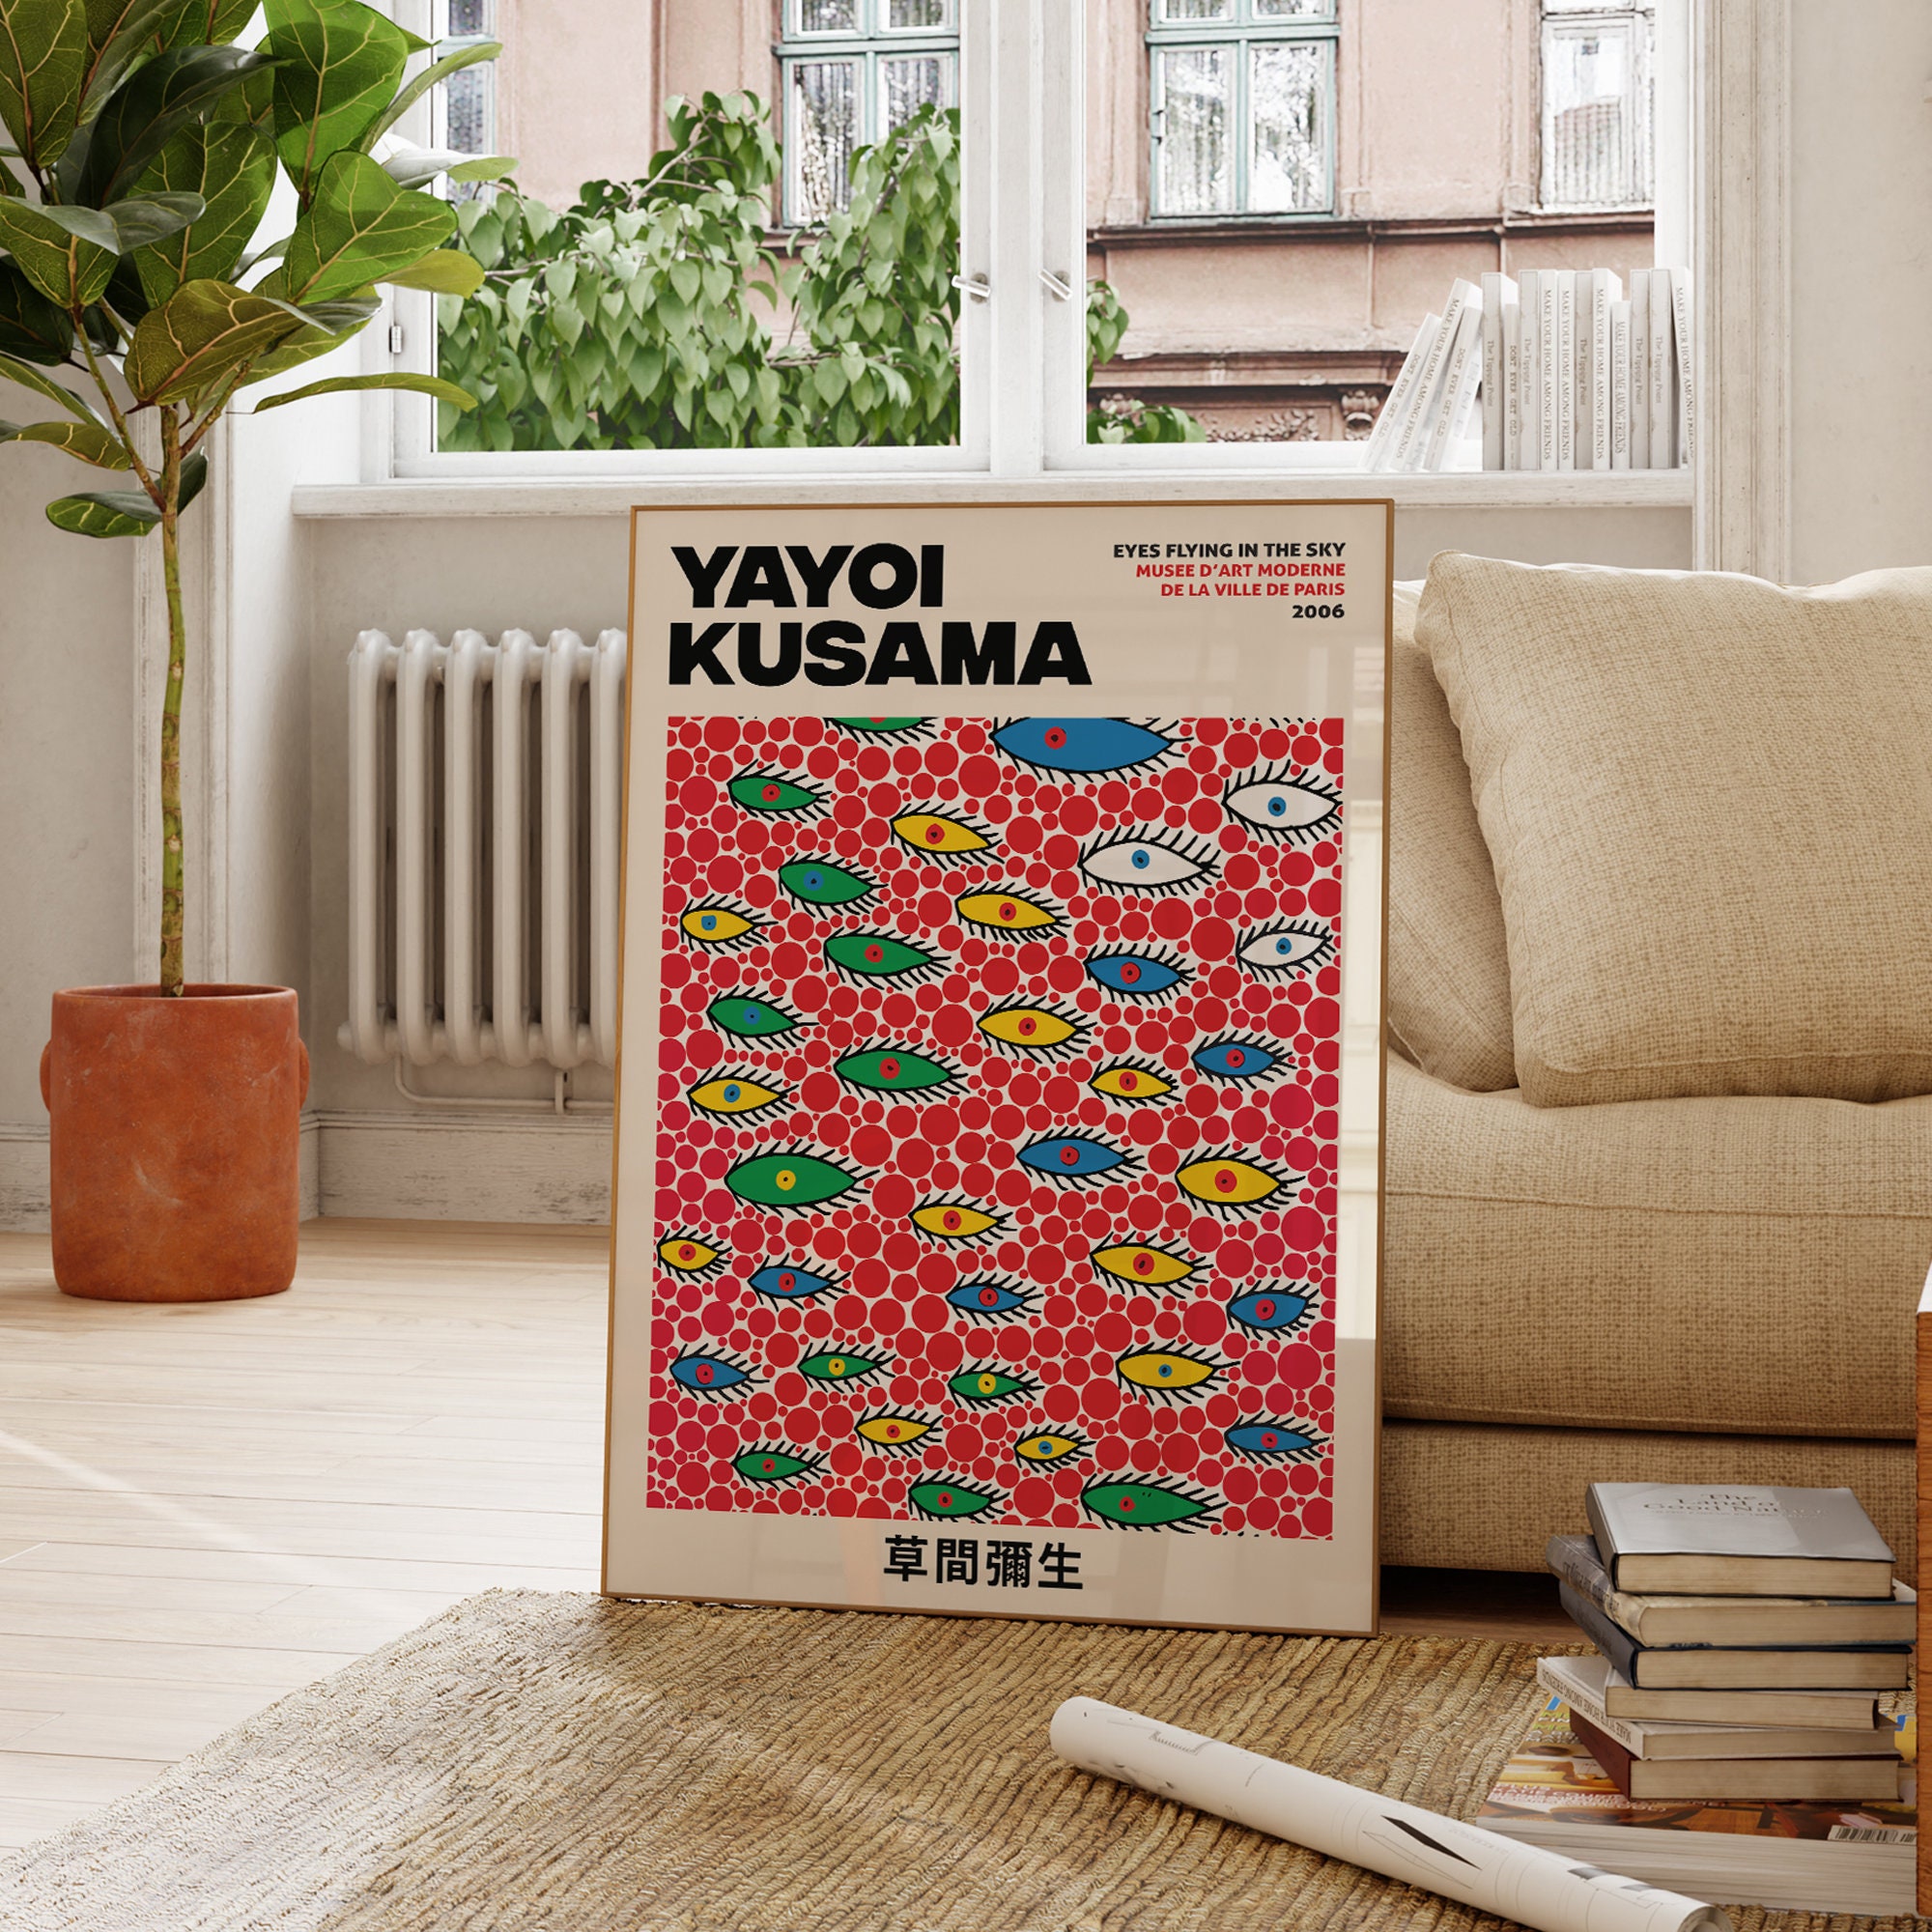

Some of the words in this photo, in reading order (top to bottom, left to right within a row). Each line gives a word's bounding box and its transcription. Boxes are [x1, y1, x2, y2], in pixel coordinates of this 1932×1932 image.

[1447, 298, 1460, 326] MAKE
[1596, 289, 1605, 317] MAKE
[1676, 286, 1685, 315] MAKE
[1434, 325, 1450, 353] YOUR
[1596, 319, 1605, 346] YOUR
[1425, 351, 1440, 384] HOME
[1485, 356, 1494, 384] Tipping
[1577, 355, 1587, 382] Tipping
[1596, 347, 1605, 380] HOME
[1411, 384, 1429, 419] AMONG
[1596, 380, 1605, 415] AMONG
[1397, 417, 1415, 458] FRIENDS
[1596, 416, 1605, 460] FRIENDS
[1114, 544, 1160, 558] EYES
[1166, 544, 1233, 558] FLYING
[1239, 543, 1258, 557] IN
[1264, 543, 1301, 557] THE
[1306, 543, 1346, 557] SKY
[670, 543, 944, 610] YAYOI
[1136, 564, 1195, 578] MUSEE
[1258, 563, 1346, 577] MODERNE
[1160, 583, 1184, 597] DE
[1189, 583, 1210, 597] LA
[1214, 583, 1262, 596] VILLE
[1266, 583, 1290, 596] DE
[1294, 582, 1346, 596] PARIS
[1293, 604, 1346, 619] 2006
[669, 620, 1092, 687] KUSAMA
[884, 1535, 1083, 1590] 草間彌生
